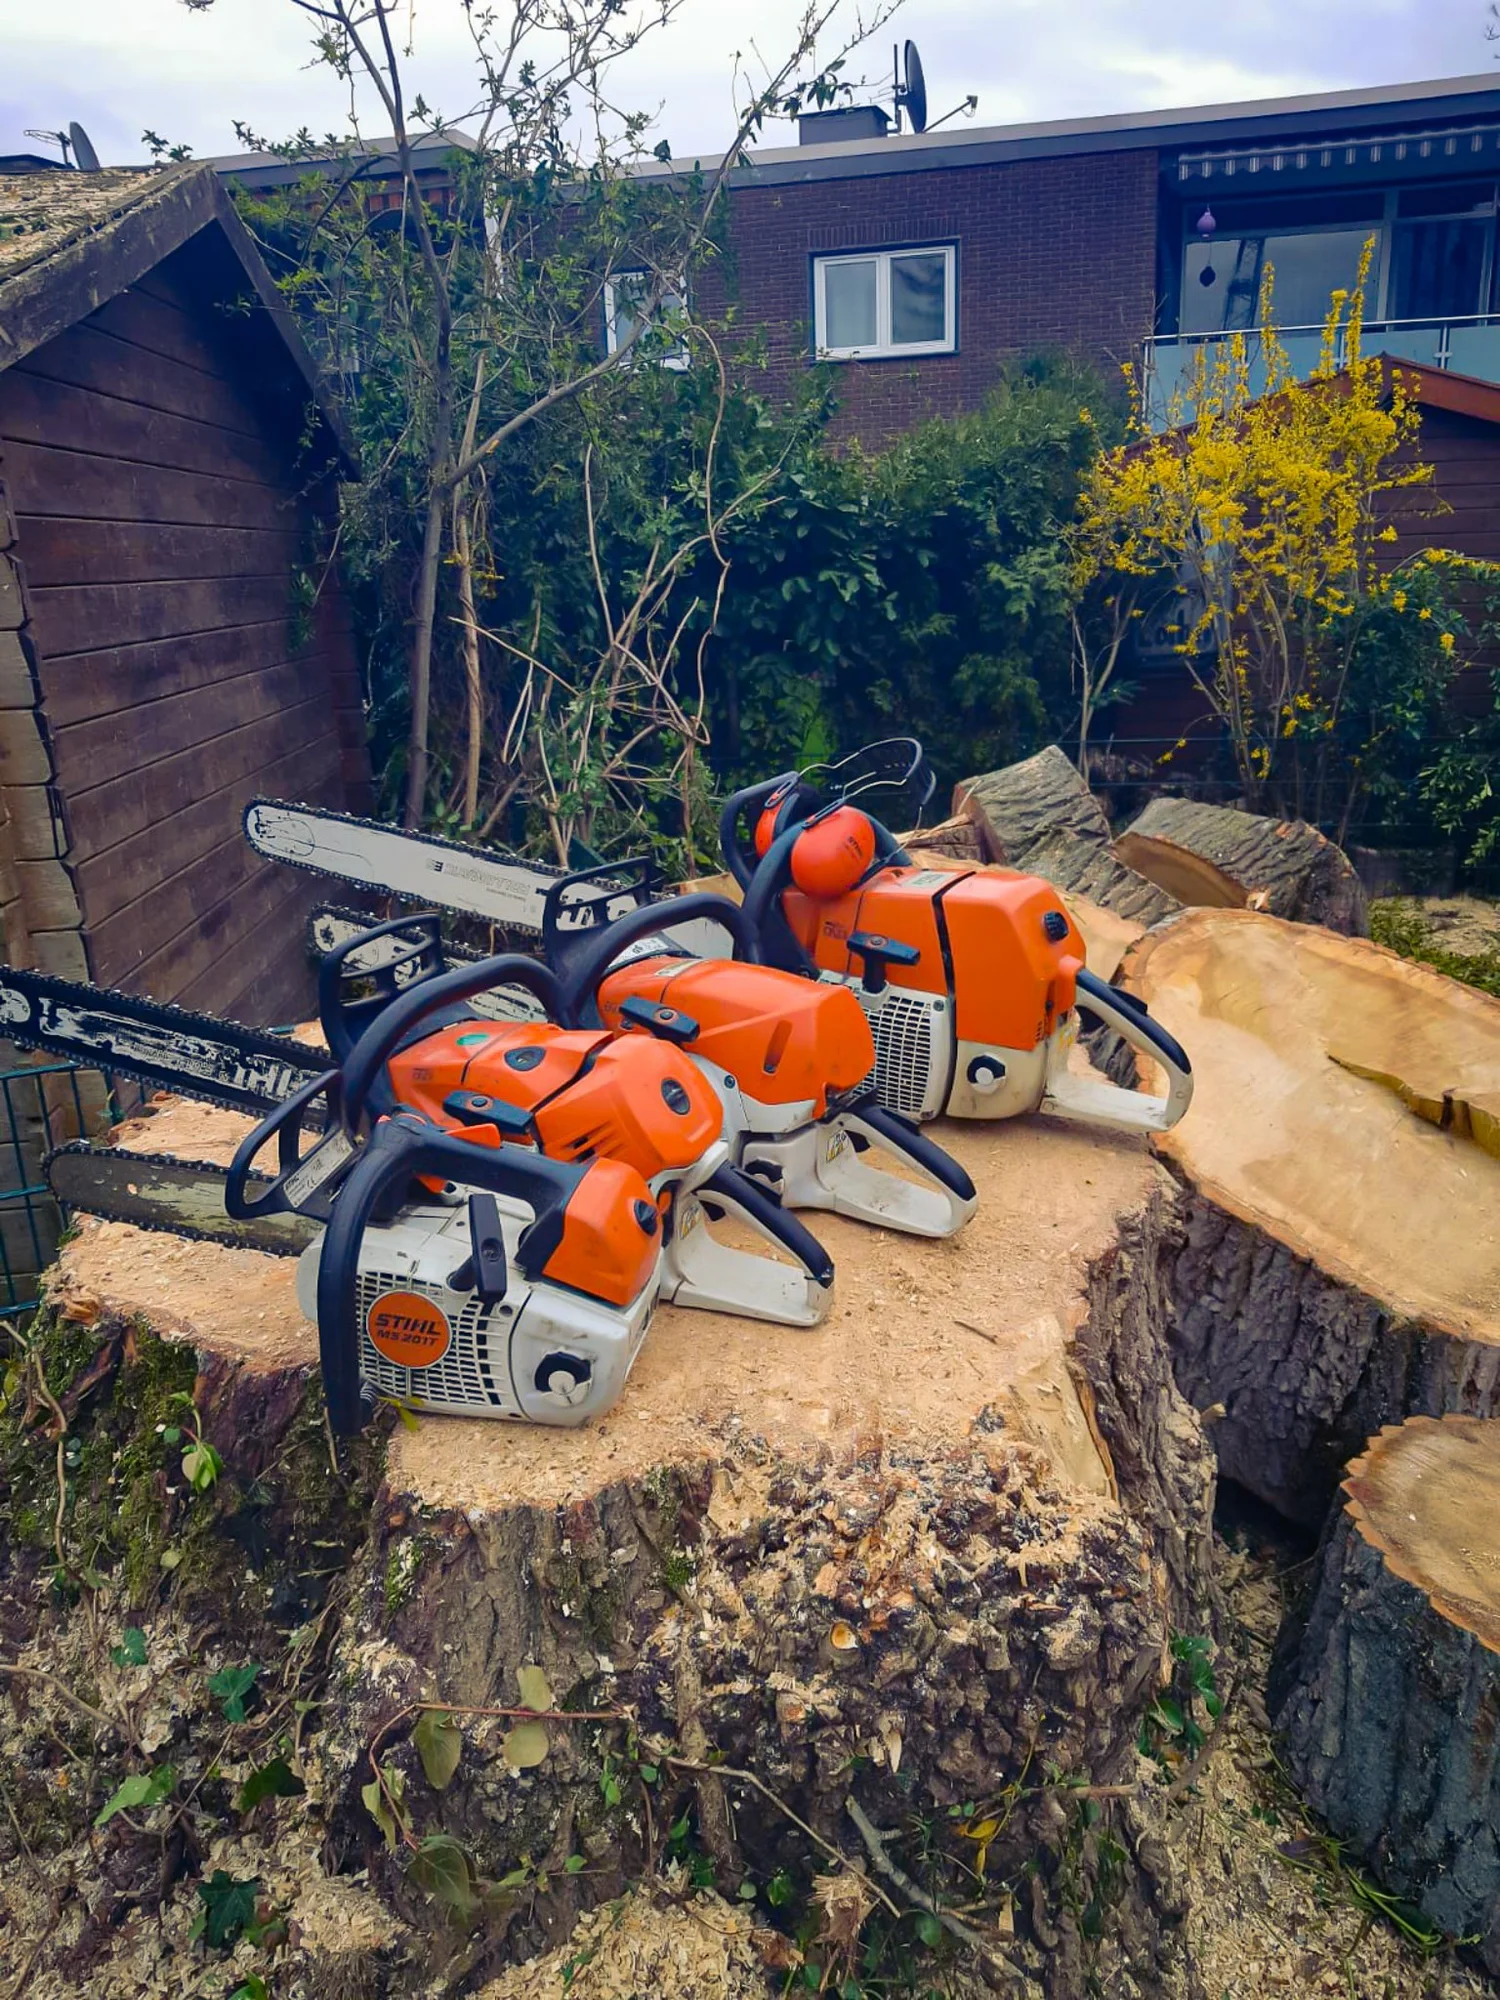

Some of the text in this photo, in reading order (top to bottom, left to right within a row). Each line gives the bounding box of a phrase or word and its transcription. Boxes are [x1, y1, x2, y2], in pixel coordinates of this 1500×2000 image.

[376, 1312, 441, 1336] STIHL
[377, 1329, 438, 1346] MS 201T
